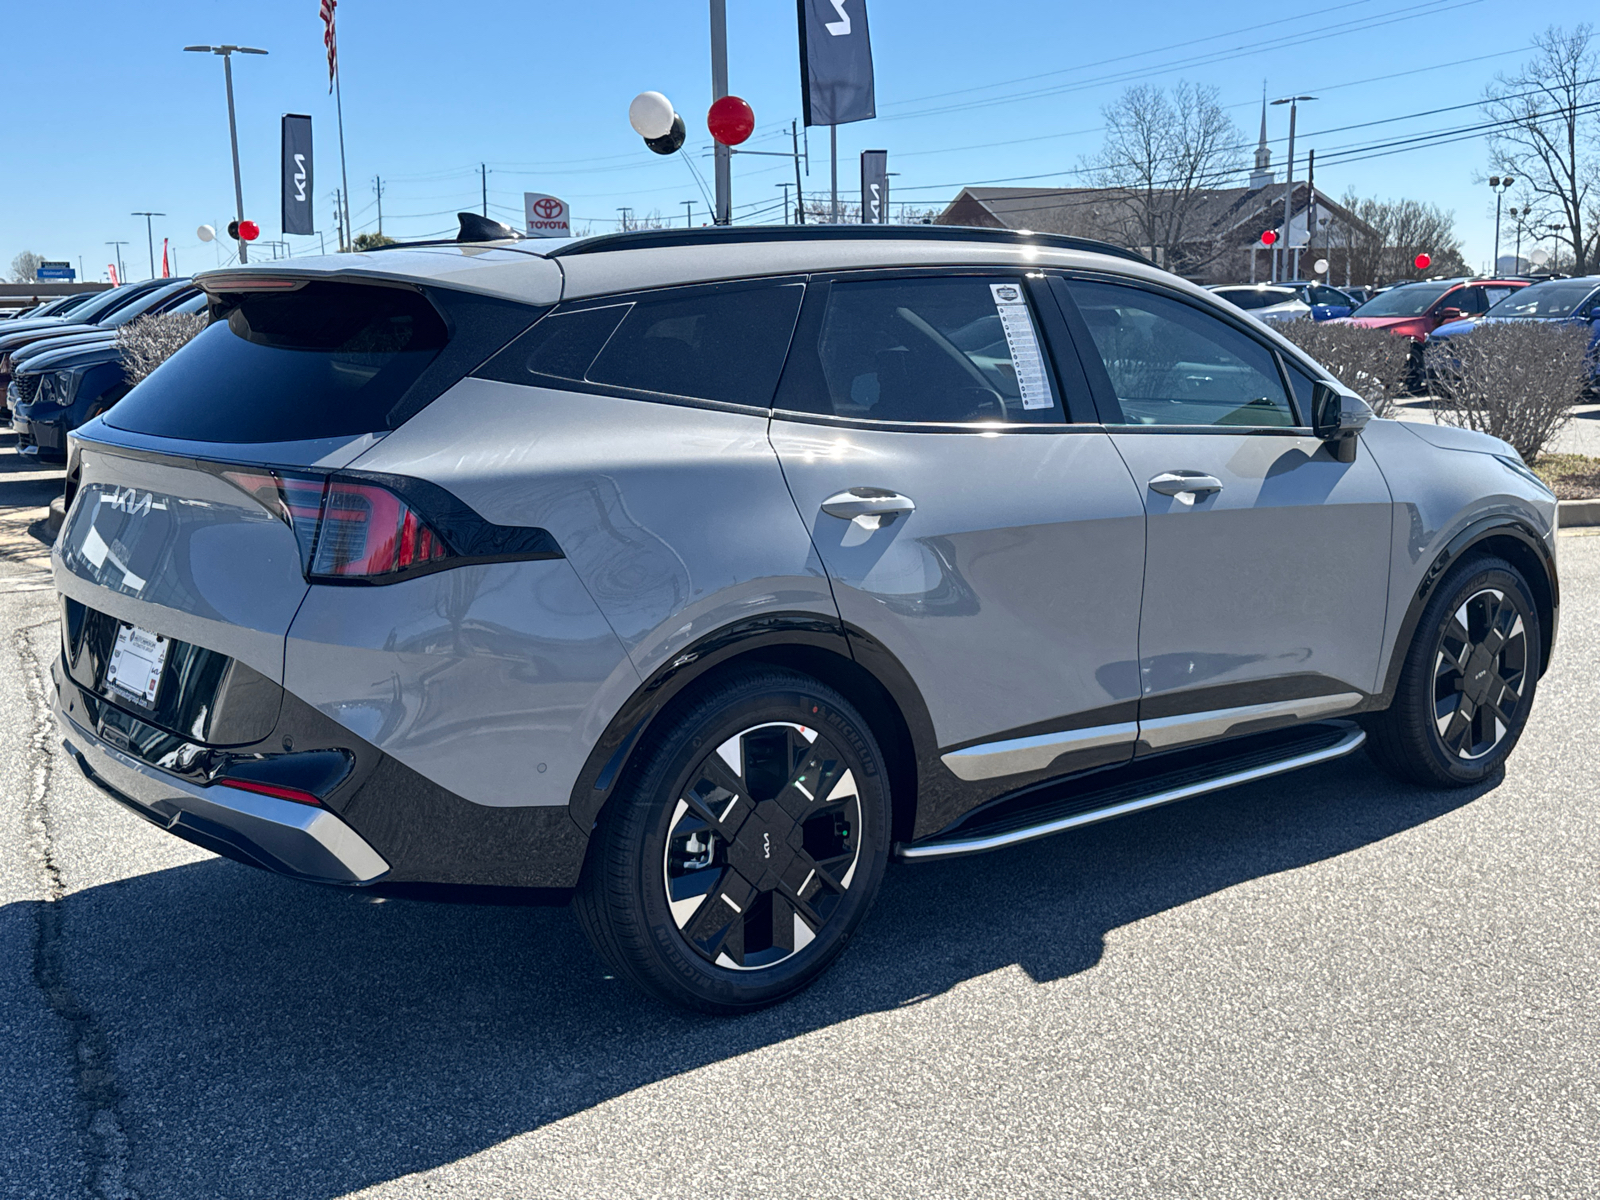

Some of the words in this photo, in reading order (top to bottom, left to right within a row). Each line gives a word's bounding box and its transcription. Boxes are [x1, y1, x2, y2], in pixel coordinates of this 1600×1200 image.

[528, 220, 569, 230] TOYOTA
[827, 710, 876, 775] MICHELIN
[655, 926, 713, 989] MICHELIN
